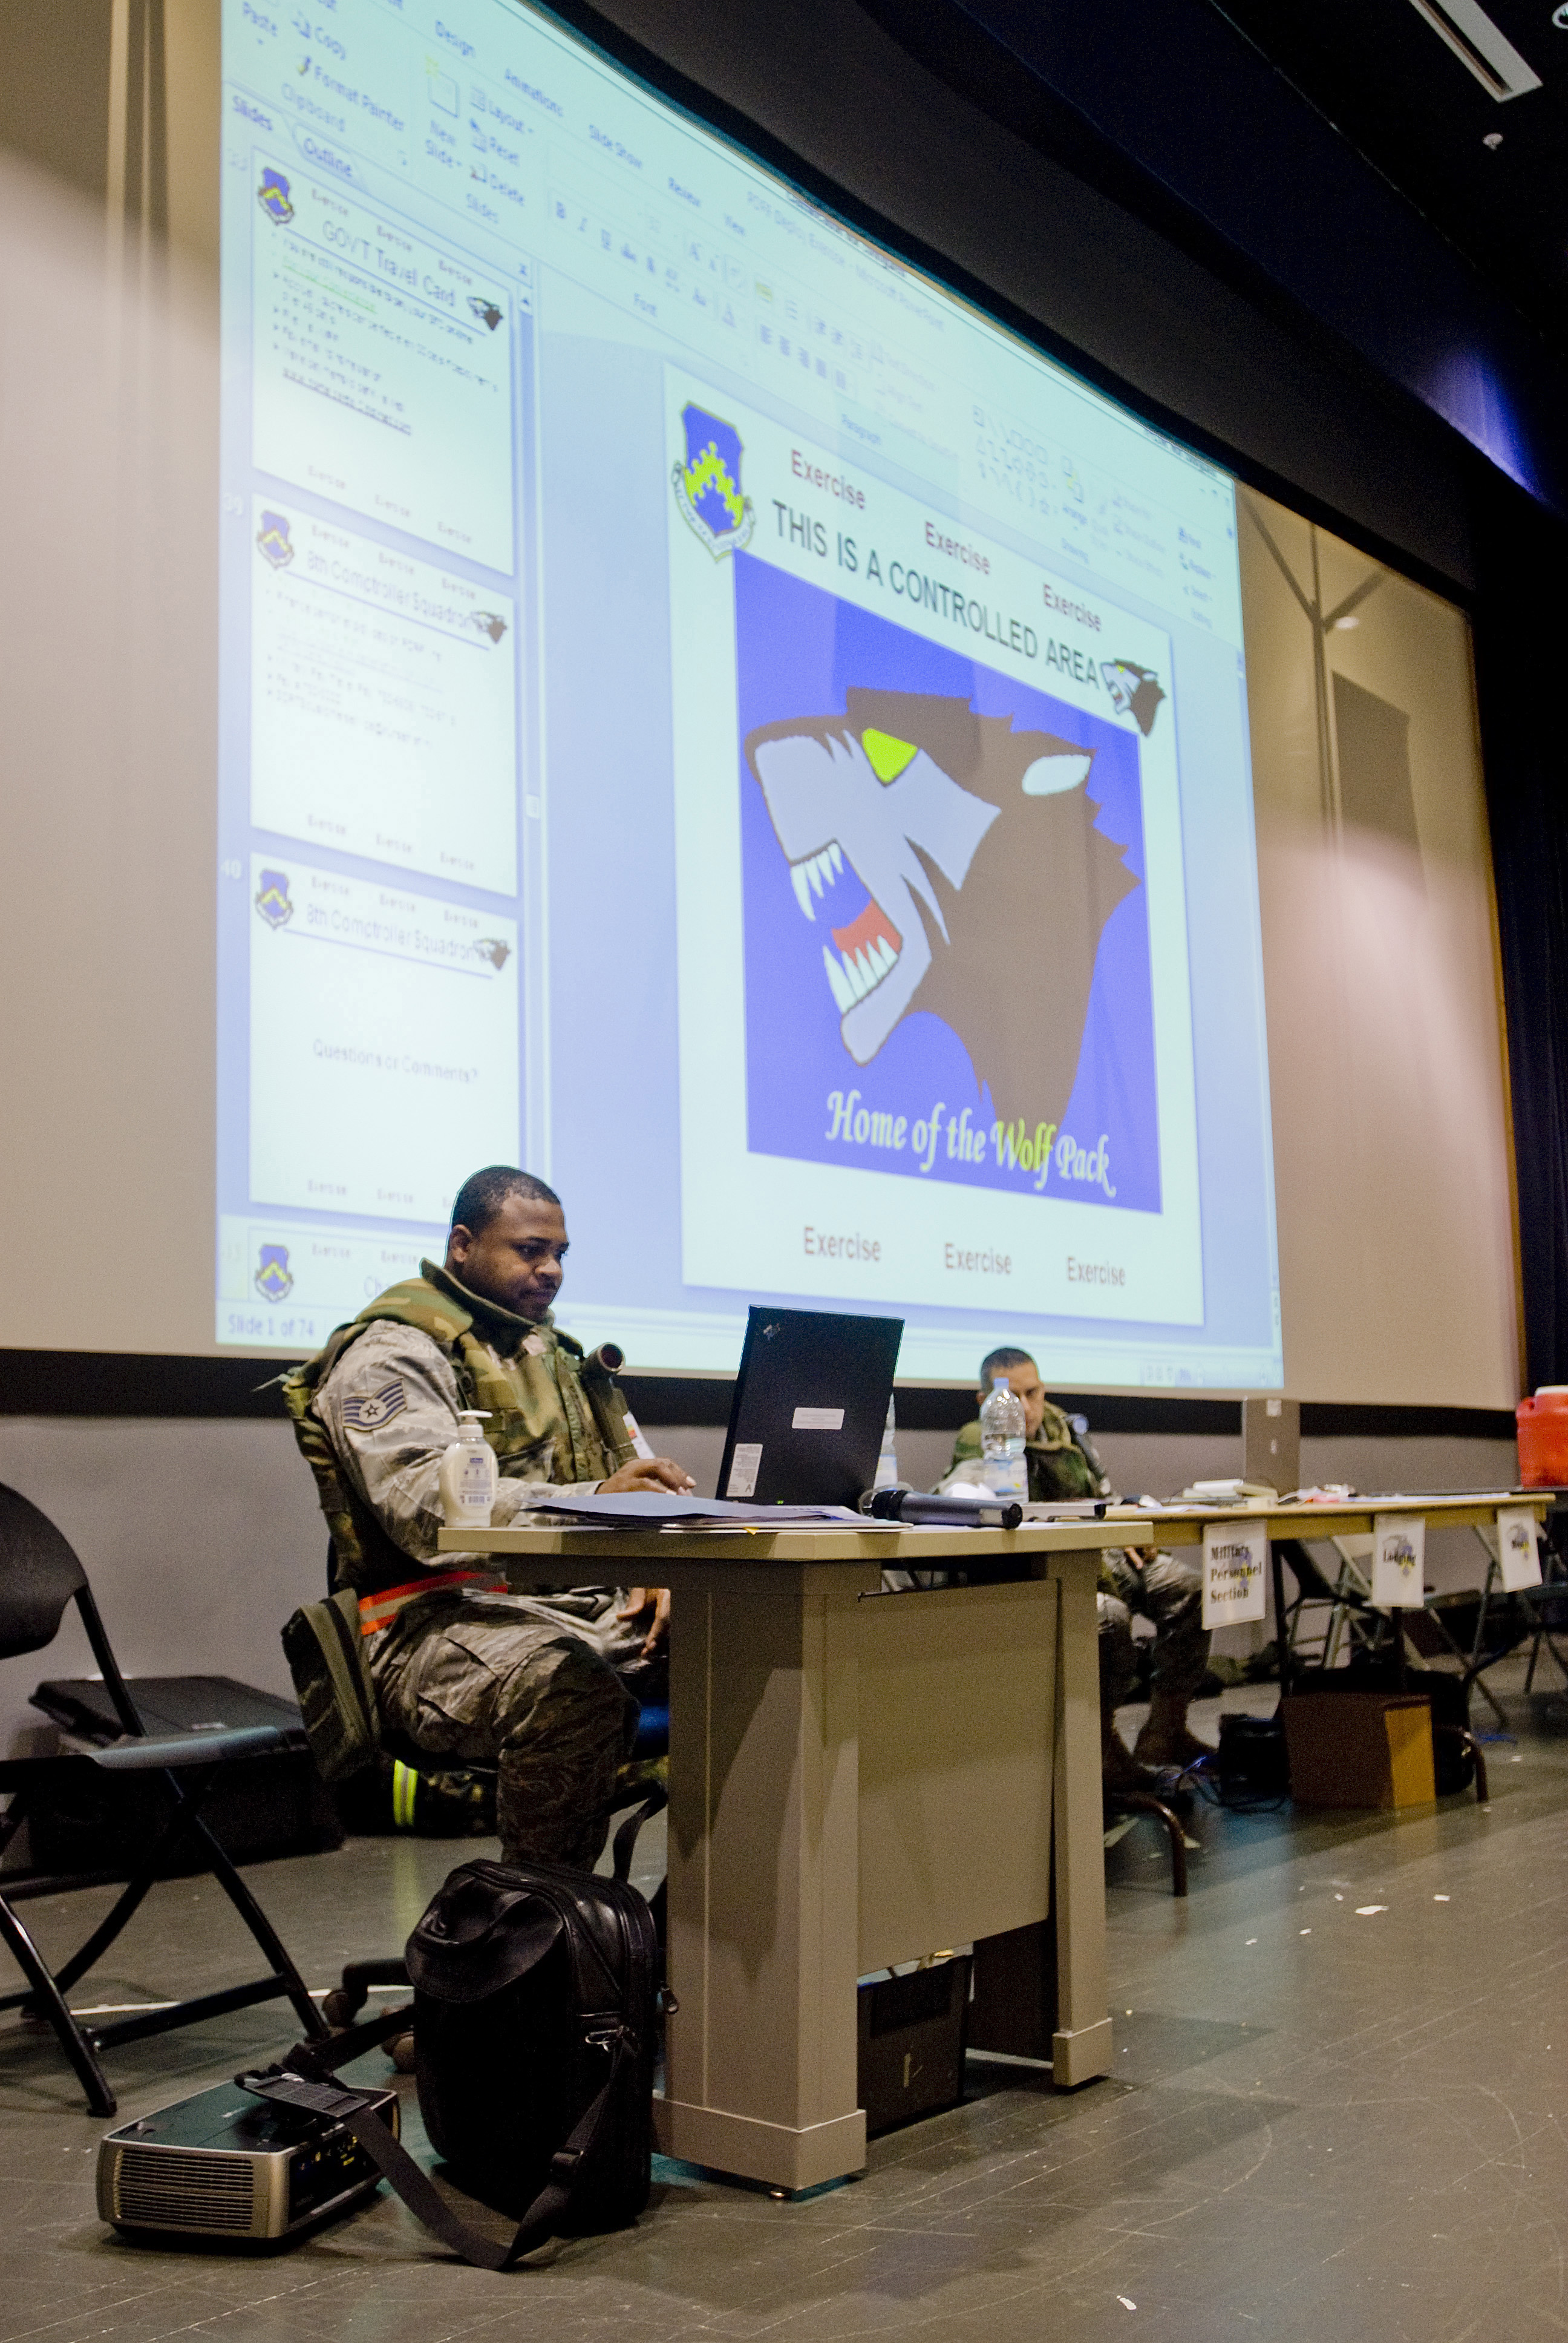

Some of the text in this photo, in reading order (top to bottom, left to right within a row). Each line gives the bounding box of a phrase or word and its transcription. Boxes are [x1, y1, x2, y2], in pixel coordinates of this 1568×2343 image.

[772, 499, 827, 558] THIS
[837, 531, 858, 573] IS
[866, 549, 884, 587] A
[889, 560, 1038, 659] CONTROLLED
[1046, 638, 1102, 690] AREA
[791, 448, 1102, 633] Exercise Exercise Exercise
[825, 1089, 1117, 1198] Home of the Wolf Pack
[804, 1226, 1126, 1288] Exercise Exercise Exercise
[1210, 1587, 1249, 1604] Section
